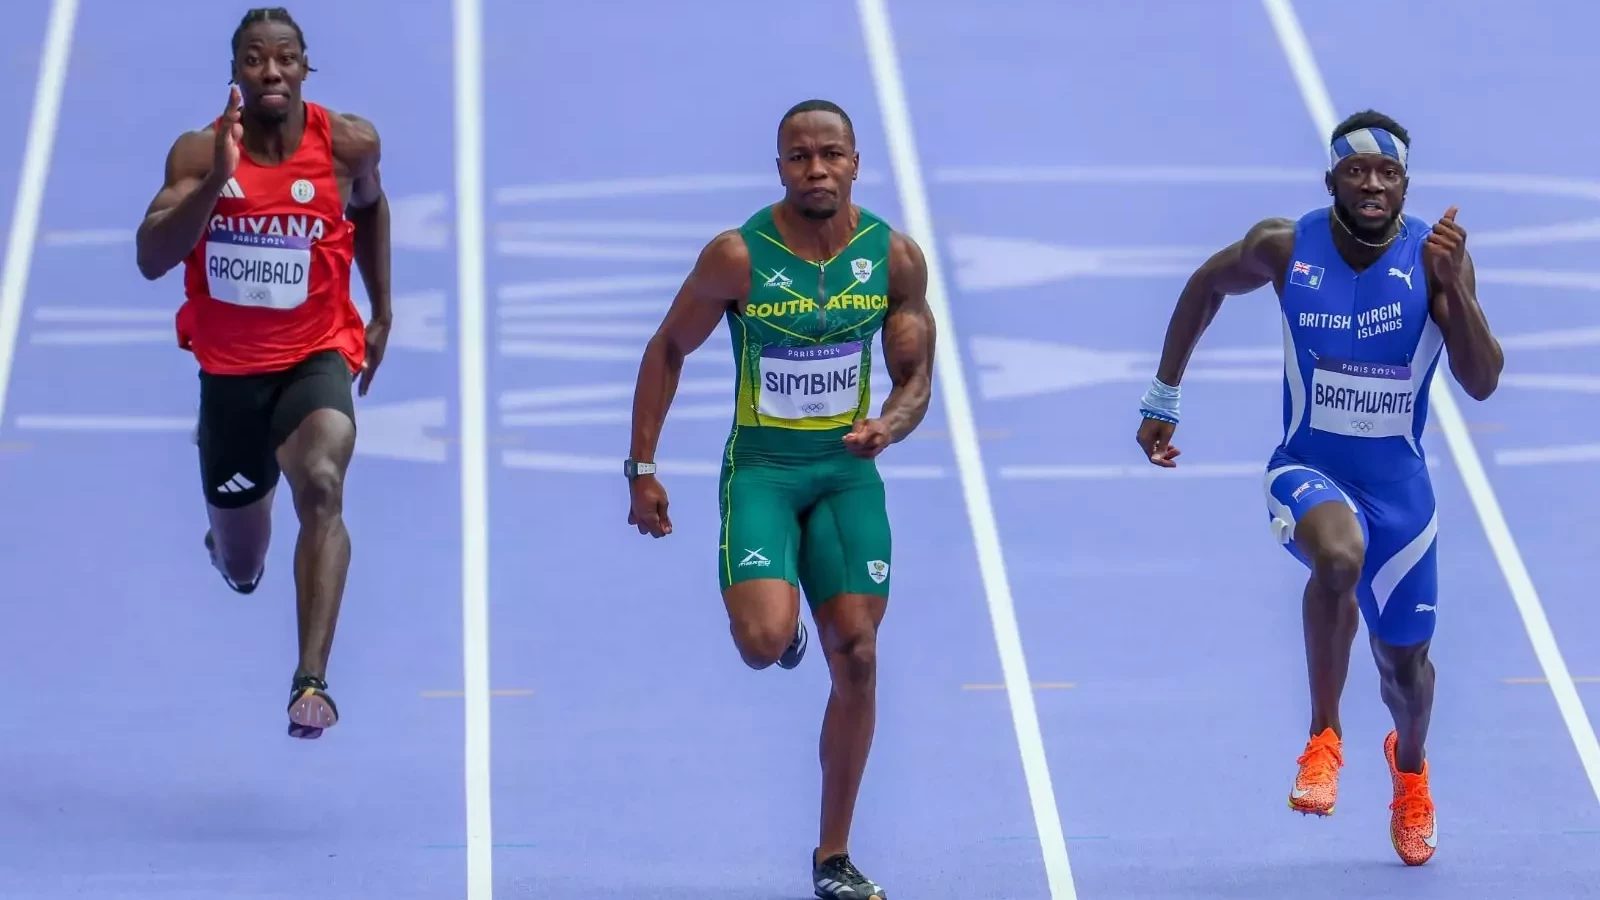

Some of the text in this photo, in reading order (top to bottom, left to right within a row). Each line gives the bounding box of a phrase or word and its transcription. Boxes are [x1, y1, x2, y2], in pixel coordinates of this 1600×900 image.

[209, 214, 325, 240] GUYANA
[232, 234, 286, 245] PARIS 2024
[208, 255, 304, 285] ARCHIBALD
[745, 294, 889, 318] SOUTH AFRICA
[1299, 301, 1402, 330] BRITISH VIRGIN
[1357, 318, 1403, 340] ISLANDS
[788, 348, 841, 358] PARIS 2024
[765, 365, 858, 396] SIMBINE
[1342, 363, 1397, 376] PARIS 2024
[1315, 383, 1412, 414] BRATHWAITE
